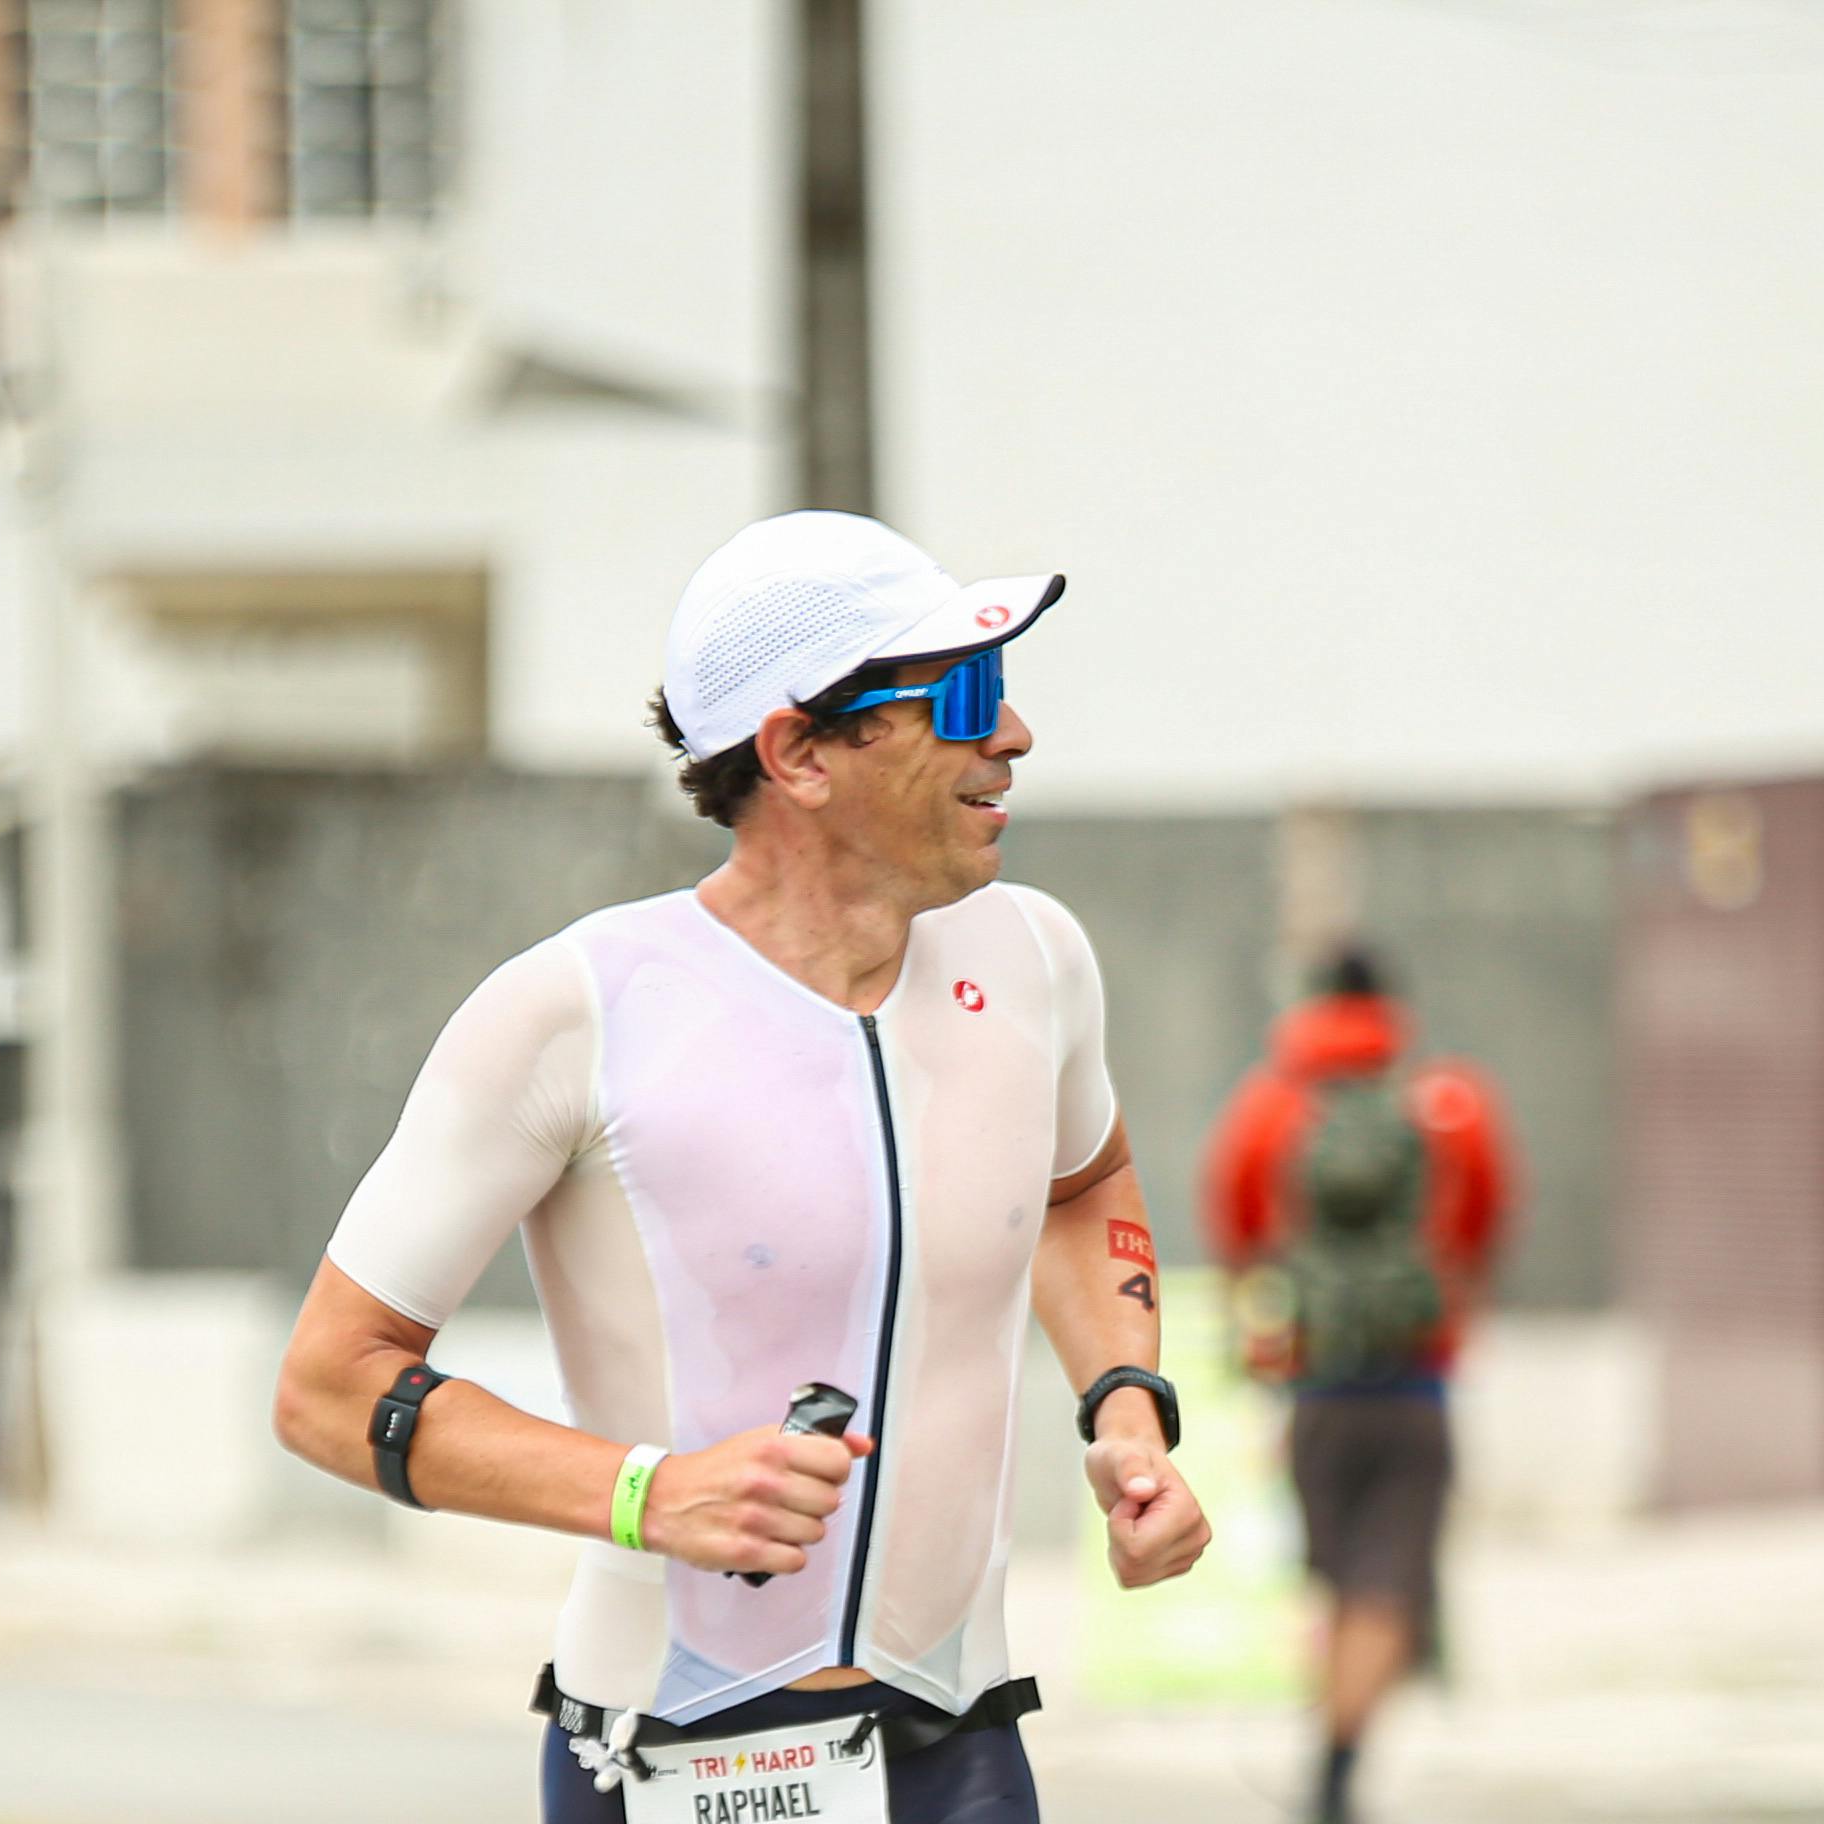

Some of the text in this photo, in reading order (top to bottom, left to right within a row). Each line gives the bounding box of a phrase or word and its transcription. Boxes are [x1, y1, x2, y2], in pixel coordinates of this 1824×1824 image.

[1118, 1272, 1155, 1312] 4
[689, 1745, 816, 1780] TRI HARD
